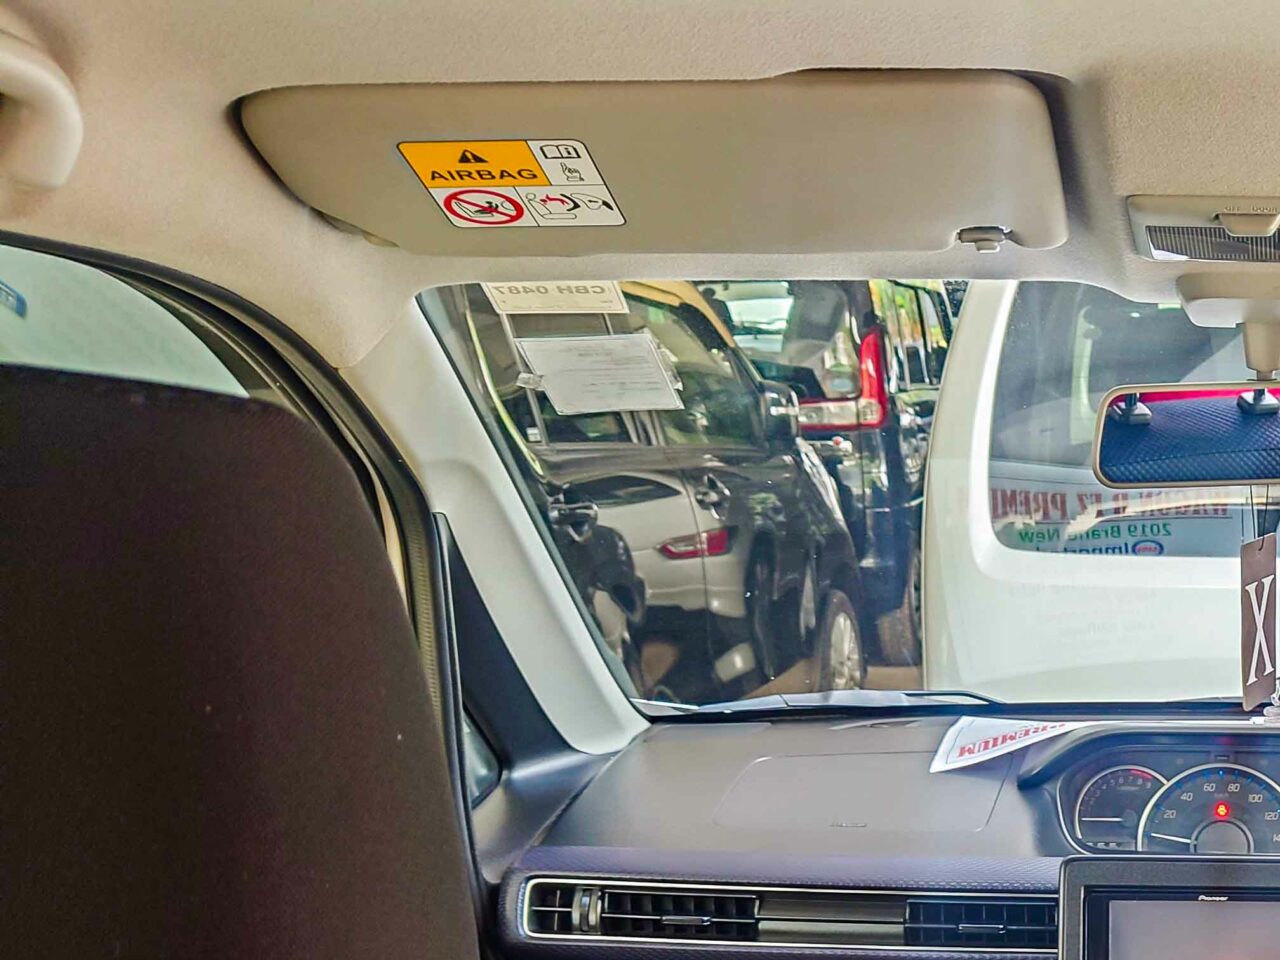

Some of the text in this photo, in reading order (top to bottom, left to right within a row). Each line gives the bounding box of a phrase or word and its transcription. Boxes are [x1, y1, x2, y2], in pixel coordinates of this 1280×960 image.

[430, 168, 538, 182] AIRBAG
[1203, 783, 1216, 792] 60
[1227, 783, 1240, 792] 80
[1180, 792, 1193, 802] 40
[1163, 809, 1176, 819] 20
[1264, 811, 1279, 820] 120
